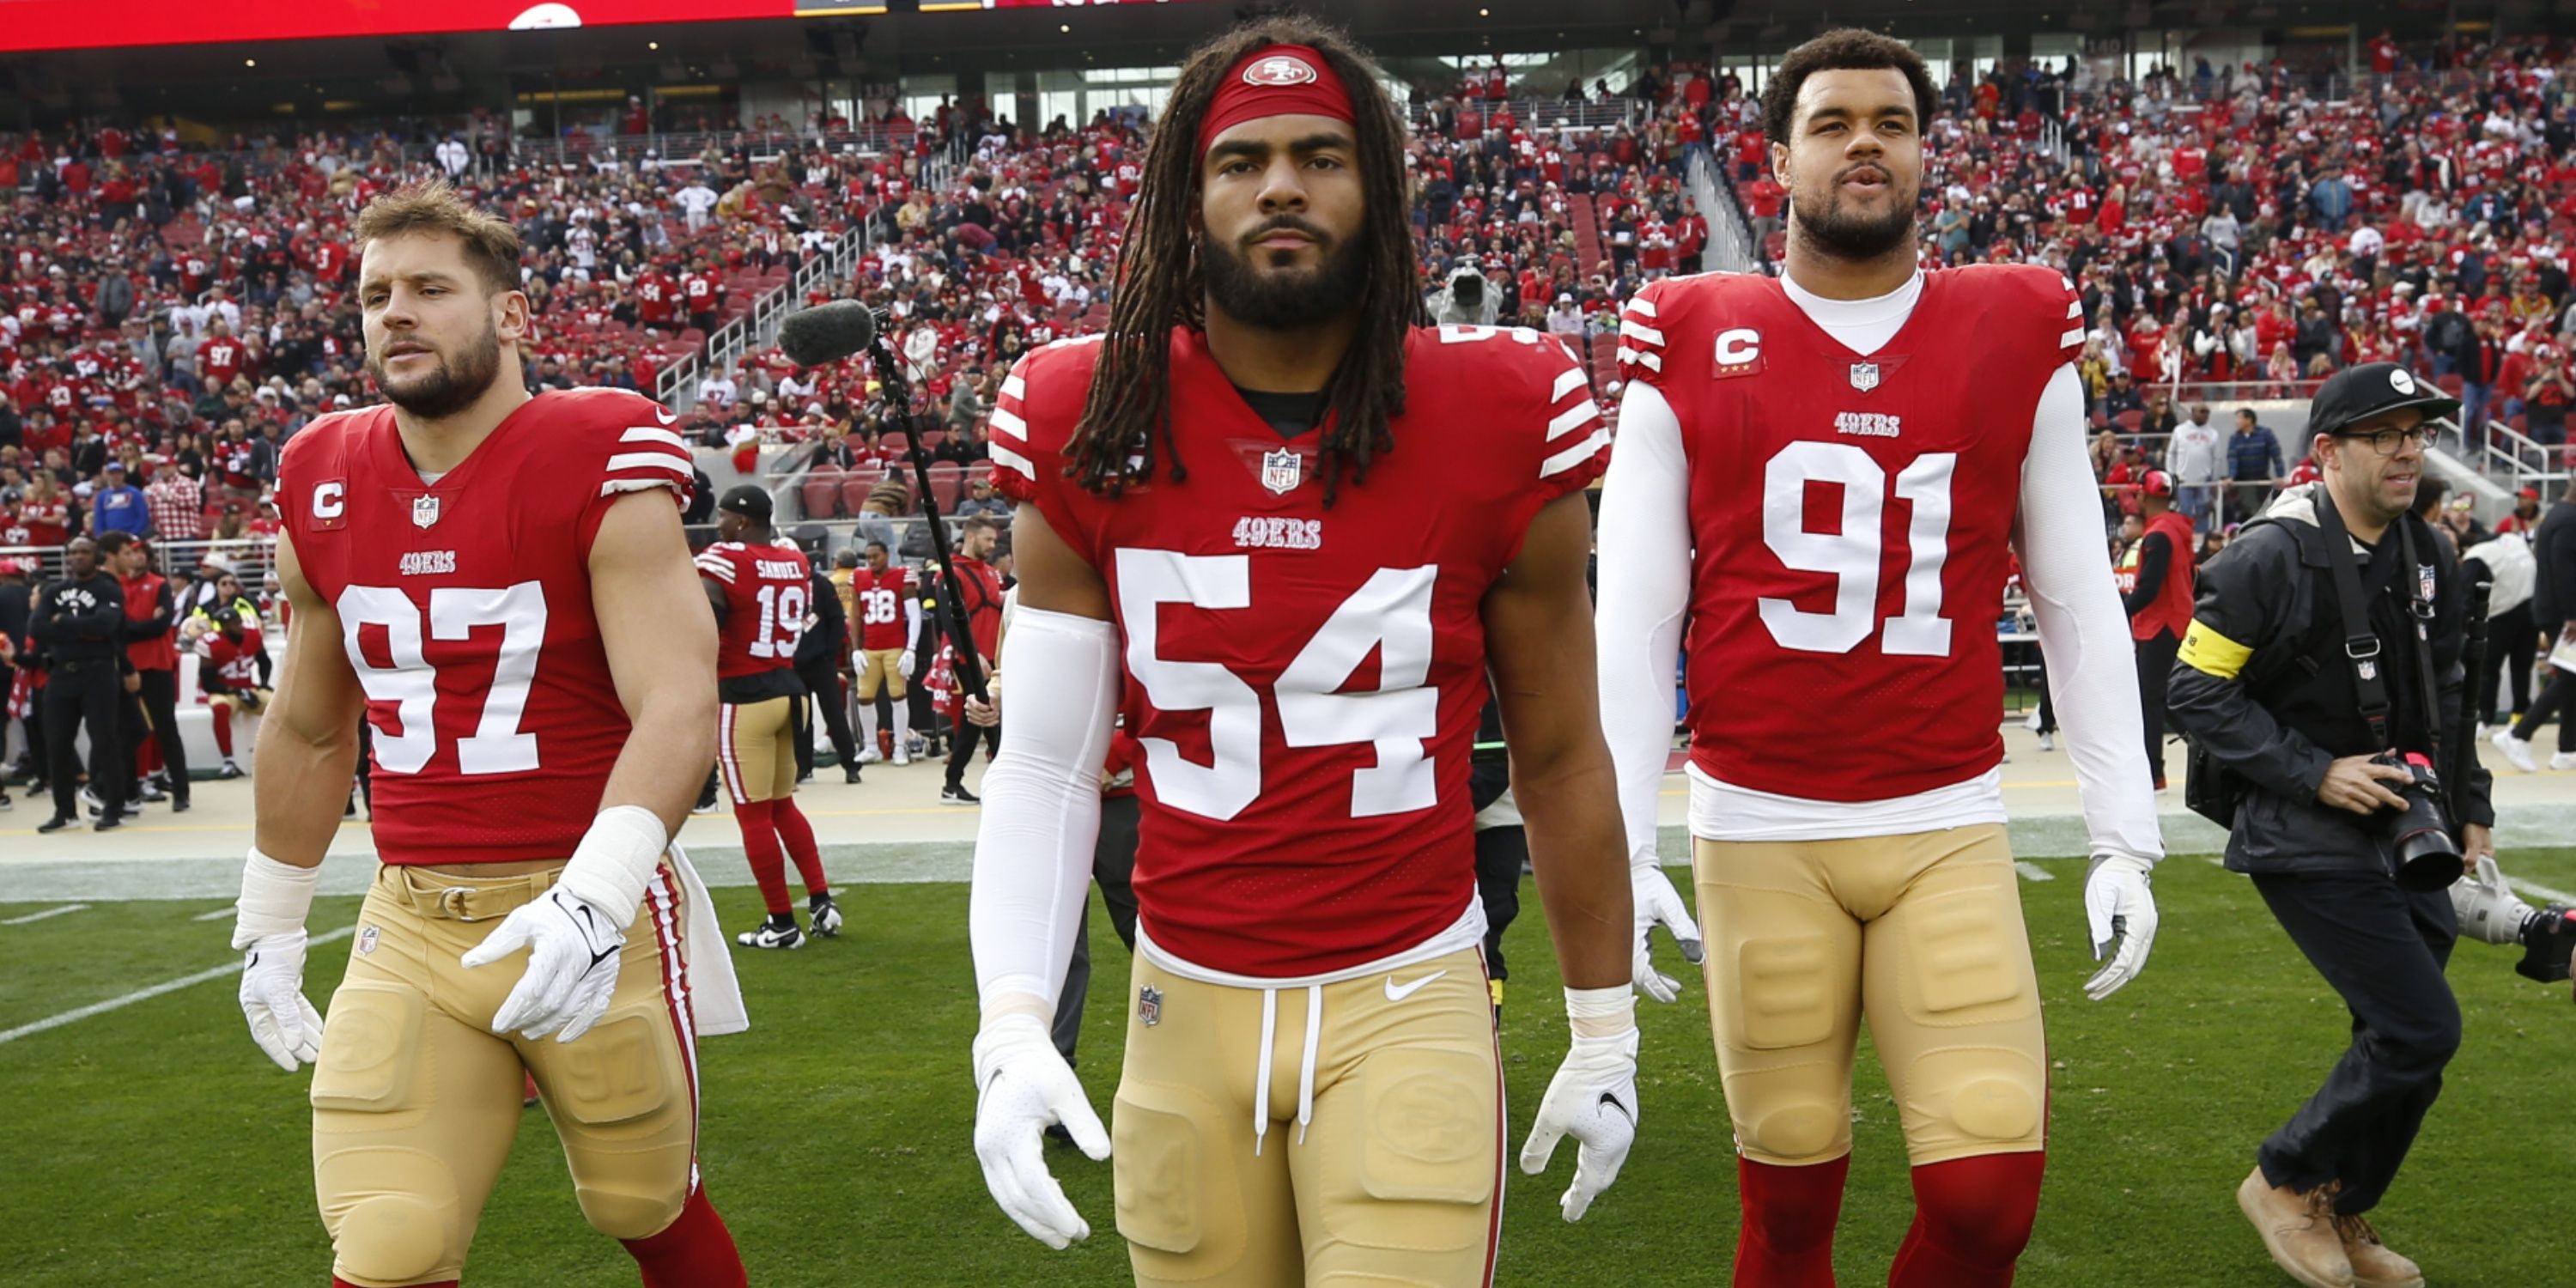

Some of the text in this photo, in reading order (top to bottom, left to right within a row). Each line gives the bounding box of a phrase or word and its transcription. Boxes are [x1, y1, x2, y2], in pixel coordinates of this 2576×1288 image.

[643, 283, 660, 301] 54
[689, 279, 708, 296] 23
[210, 345, 234, 367] 97
[1716, 328, 1760, 365] C
[1834, 411, 1900, 437] 49ERS
[313, 481, 344, 518] C
[1231, 517, 1322, 550] 49ERS
[1758, 440, 1958, 657] 91
[399, 550, 457, 575] 49ERS
[756, 559, 804, 580] SAMUEL
[749, 585, 805, 659] 19
[860, 589, 896, 625] 38
[218, 656, 256, 678] 45
[336, 580, 549, 775] 97
[1115, 547, 1438, 821] 54
